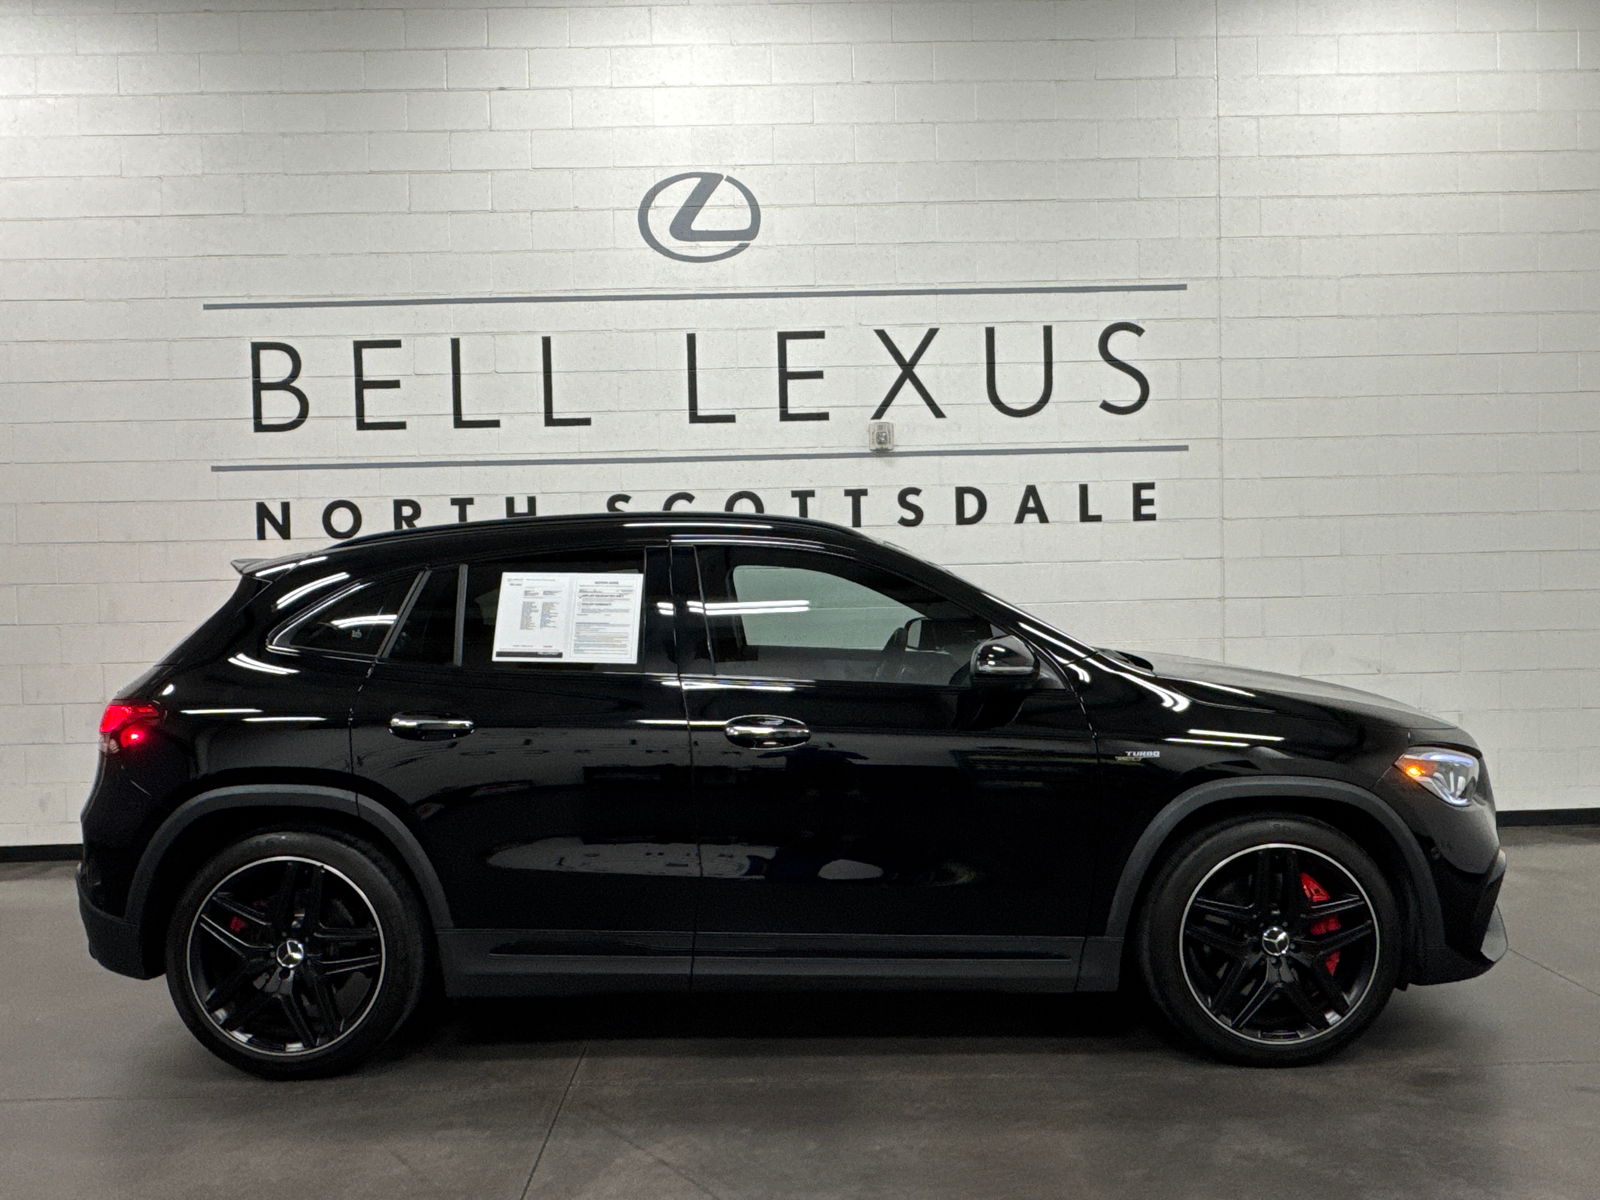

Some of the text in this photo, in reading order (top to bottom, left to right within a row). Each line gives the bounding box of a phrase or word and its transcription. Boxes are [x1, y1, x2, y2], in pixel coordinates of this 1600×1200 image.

[250, 321, 1150, 433] BELL LEXUS
[255, 496, 537, 541] NORTH
